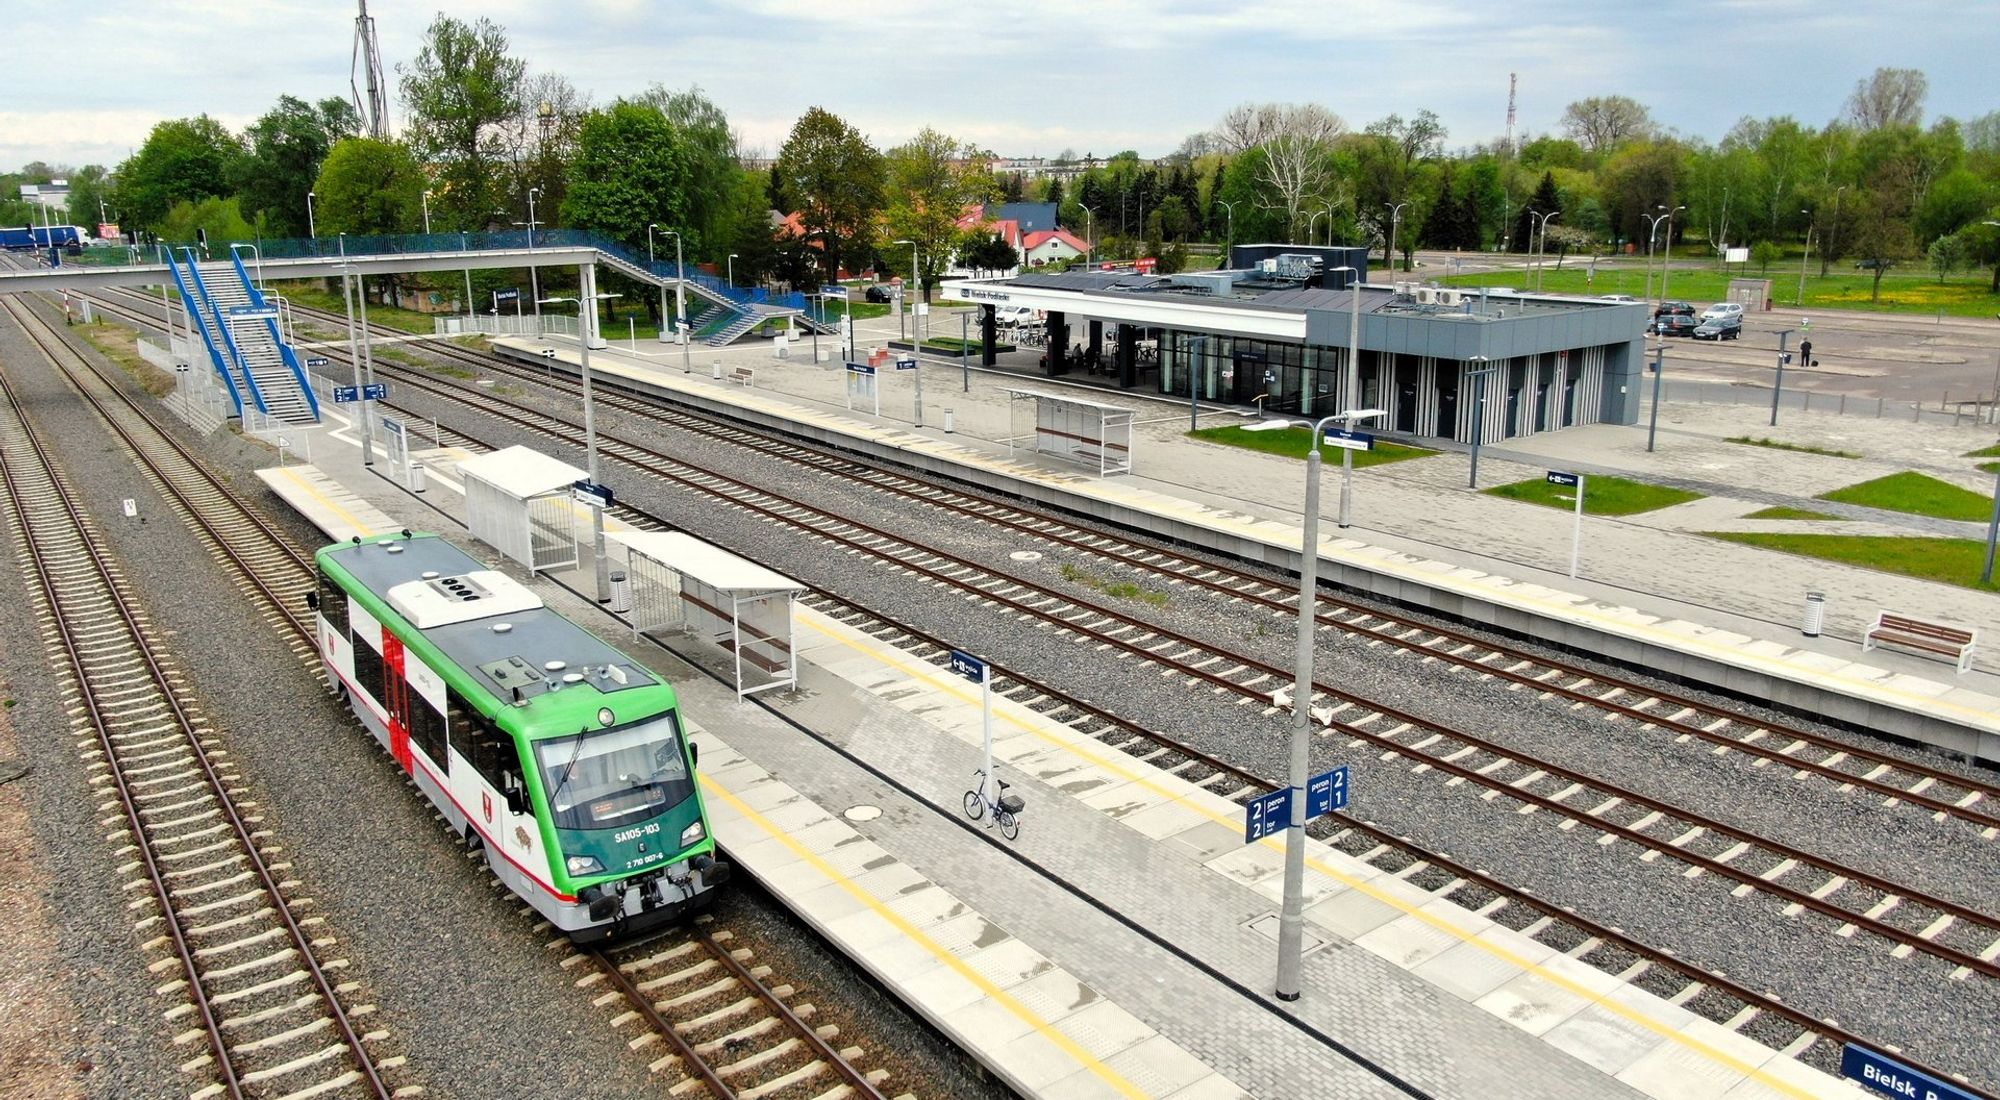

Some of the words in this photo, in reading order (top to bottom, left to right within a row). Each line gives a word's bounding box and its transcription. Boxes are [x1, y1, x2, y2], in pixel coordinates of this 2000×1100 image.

[336, 388, 342, 396] 2
[378, 384, 384, 392] 2
[1311, 779, 1330, 793] peron
[1334, 771, 1343, 788] 2
[1335, 791, 1341, 805] 1
[1252, 802, 1262, 820] 2
[1266, 796, 1286, 809] peron
[614, 822, 660, 843] SA105-103
[1252, 823, 1261, 838] 2
[1266, 820, 1276, 828] tor
[626, 861, 632, 869] 2
[1863, 1063, 1916, 1099] Bielsk
